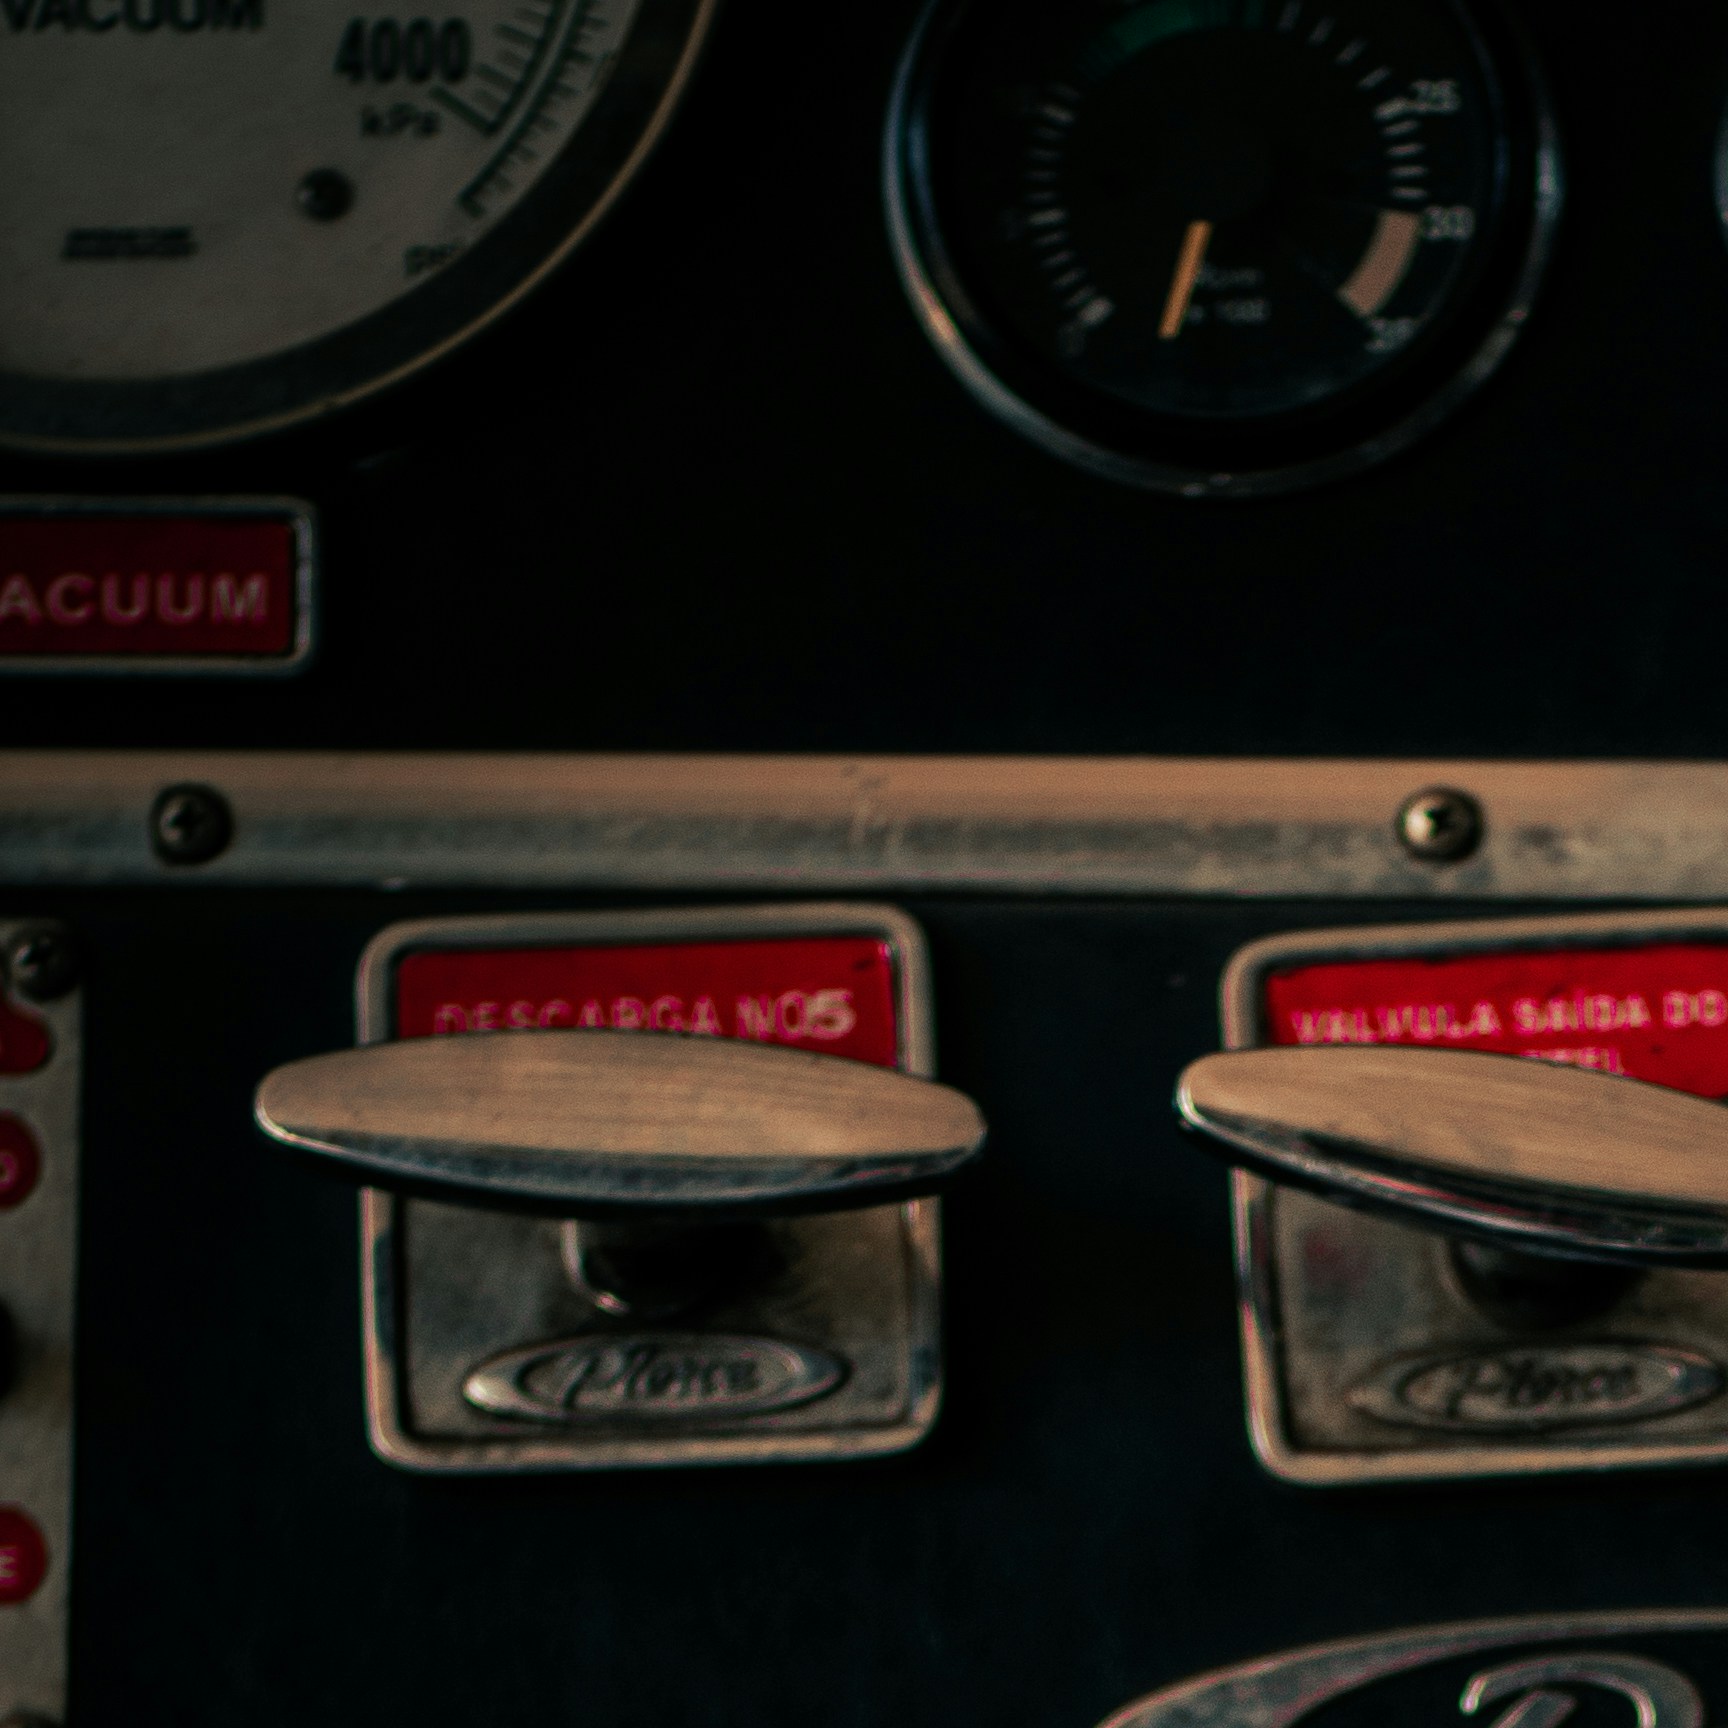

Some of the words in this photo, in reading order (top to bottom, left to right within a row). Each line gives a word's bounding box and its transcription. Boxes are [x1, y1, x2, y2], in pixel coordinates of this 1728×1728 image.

[334, 18, 470, 83] 4000
[361, 103, 441, 137] kPa
[0, 572, 271, 626] ACUUM
